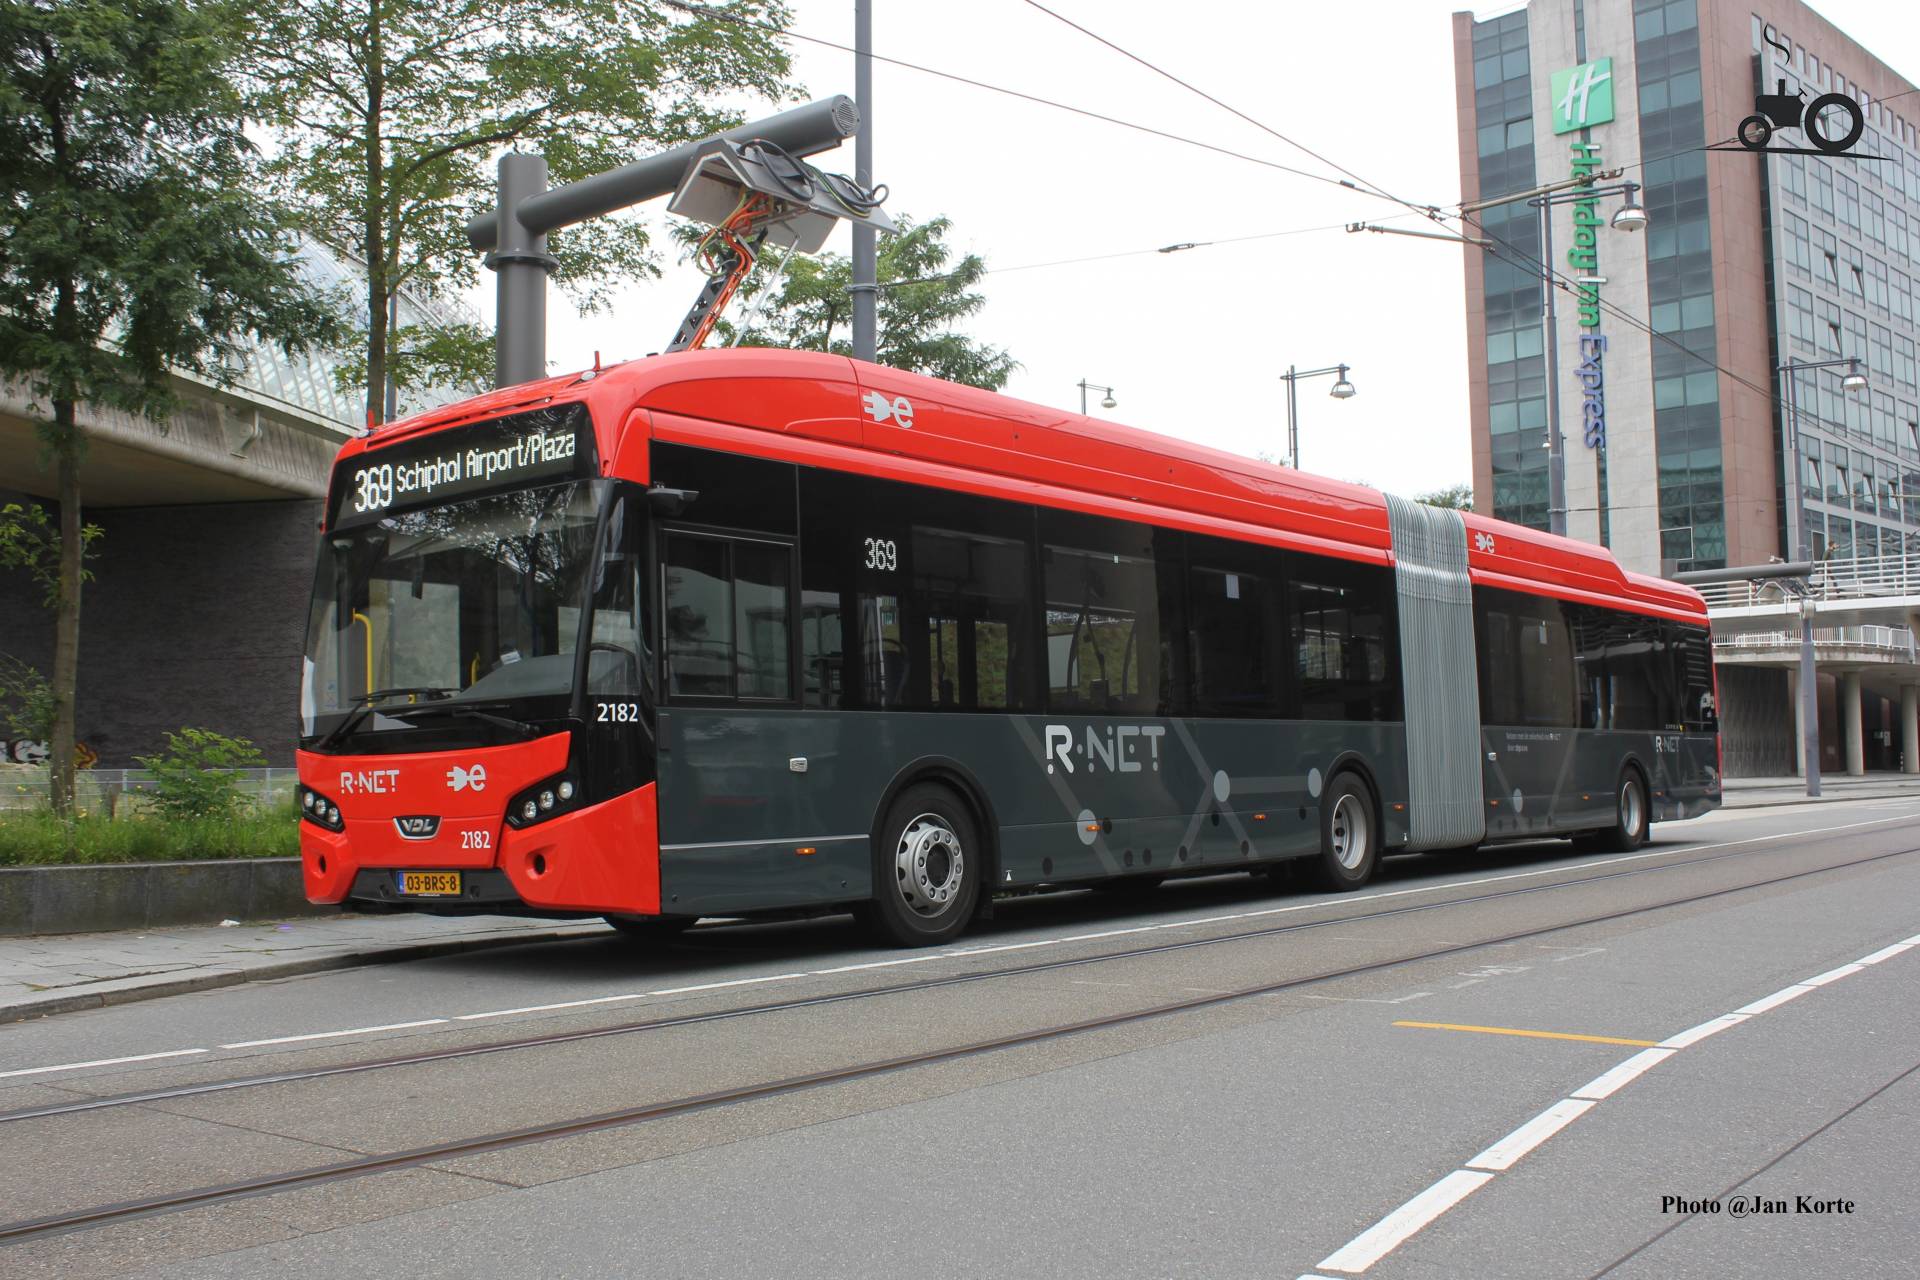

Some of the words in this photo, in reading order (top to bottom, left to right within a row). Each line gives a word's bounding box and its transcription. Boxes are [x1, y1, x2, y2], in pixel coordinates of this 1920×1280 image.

[1577, 276, 1608, 328] Inn
[1574, 334, 1607, 449] Express
[355, 464, 393, 513] 369
[396, 452, 461, 493] Schiphol
[466, 432, 576, 480] Airport/Plaza
[864, 537, 897, 571] 369
[597, 703, 639, 723] 2182
[401, 818, 434, 832] VDL
[461, 830, 491, 849] 2182
[406, 875, 457, 892] 03-BRS-8
